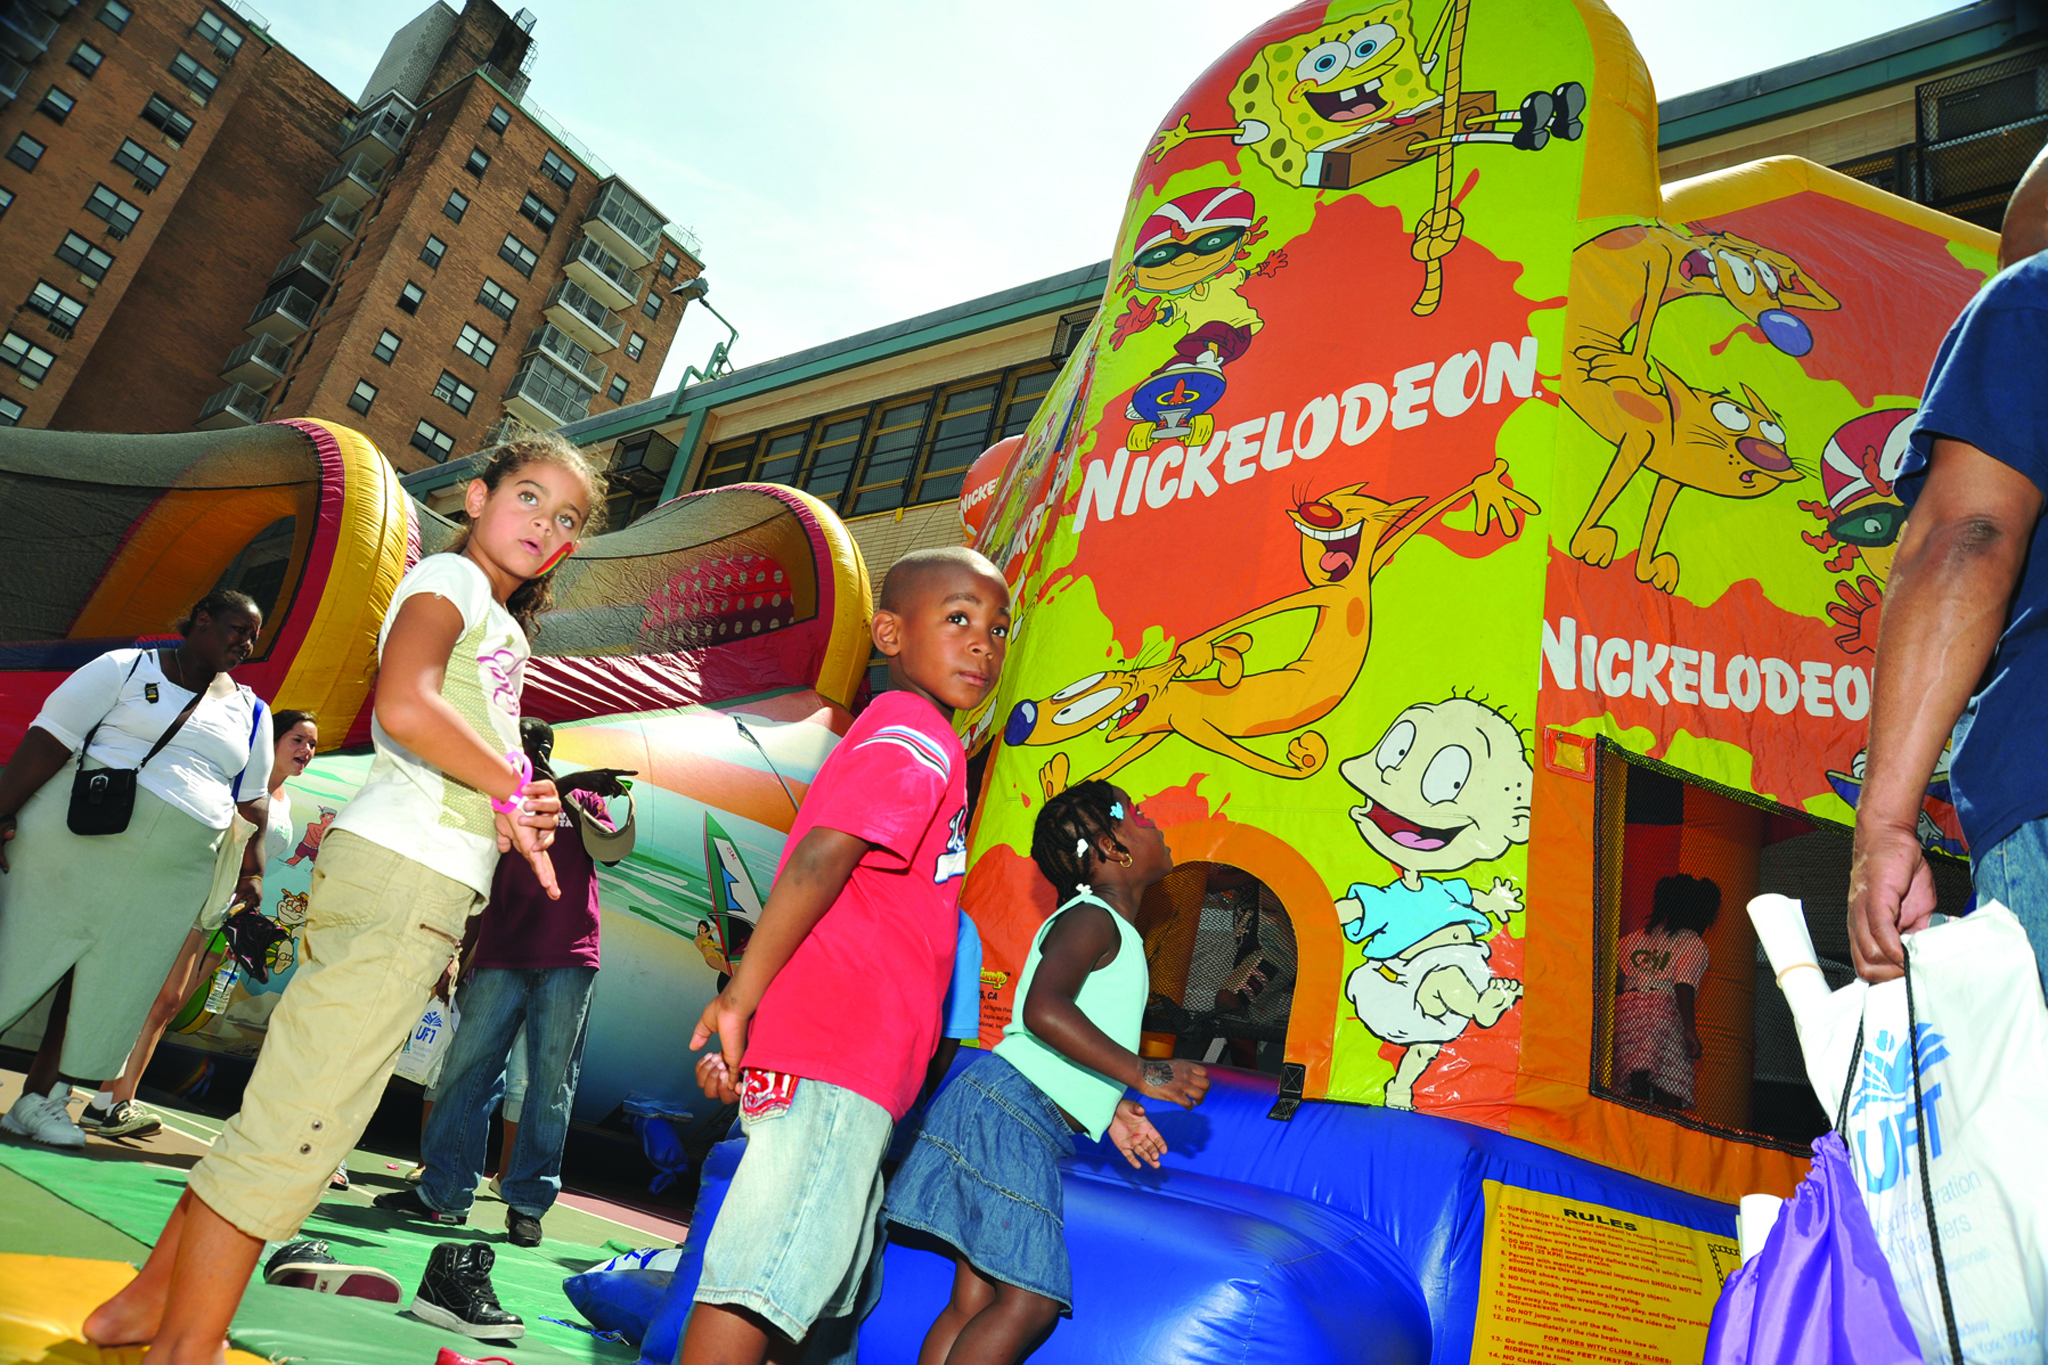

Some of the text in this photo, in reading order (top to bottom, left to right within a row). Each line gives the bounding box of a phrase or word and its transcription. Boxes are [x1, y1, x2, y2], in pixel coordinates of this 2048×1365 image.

[1072, 336, 1540, 534] NICKELODEON
[1538, 616, 1875, 721] NICKELODEO
[1858, 1082, 1943, 1195] UFT
[1902, 1170, 1982, 1225] Feration
[1507, 1205, 1550, 1219] SUPERVISION
[1567, 1219, 1594, 1228] qualified
[1595, 1225, 1624, 1234] attendant
[1535, 1219, 1553, 1227] MUST
[1565, 1226, 1592, 1235] securely
[1563, 1209, 1637, 1231] RULES
[1508, 1229, 1524, 1238] Keep
[1527, 1234, 1552, 1242] children
[1601, 1249, 1622, 1257] blower
[1545, 1230, 1571, 1238] requires
[1579, 1236, 1607, 1245] GROUND
[1624, 1246, 1654, 1256] protected
[1508, 1257, 1534, 1266] allowed
[1508, 1251, 1534, 1261] Persons
[1553, 1261, 1575, 1269] mental
[1586, 1268, 1612, 1276] physical
[1651, 1280, 1677, 1291] SHOULD
[1565, 1250, 1604, 1263] immediately
[1606, 1258, 1627, 1266] deflate
[1508, 1265, 1537, 1275] REMOVE
[1562, 1277, 1599, 1288] eyeglasses
[1627, 1289, 1645, 1298] sharp
[1507, 1292, 1521, 1301] Play
[1543, 1299, 1559, 1307] from
[1561, 1303, 1582, 1311] others
[1598, 1310, 1615, 1318] away
[1616, 1313, 1631, 1321] from
[1534, 1313, 1551, 1321] jump
[1611, 1304, 1630, 1312] rough
[1661, 1313, 1675, 1321] flips
[1505, 1315, 1522, 1323] EXIT
[1523, 1320, 1565, 1332] immediately
[1601, 1334, 1623, 1343] begins
[1633, 1340, 1647, 1348] lose
[1543, 1334, 1559, 1342] FOR
[1561, 1338, 1585, 1348] RIDES
[1587, 1343, 1607, 1352] WITH
[1609, 1347, 1633, 1356] CLIMB
[1504, 1344, 1534, 1355] RIDERS
[1518, 1341, 1539, 1349] down
[1557, 1348, 1575, 1356] slide
[1577, 1351, 1597, 1359] FEET
[1599, 1355, 1621, 1364] FIRST
